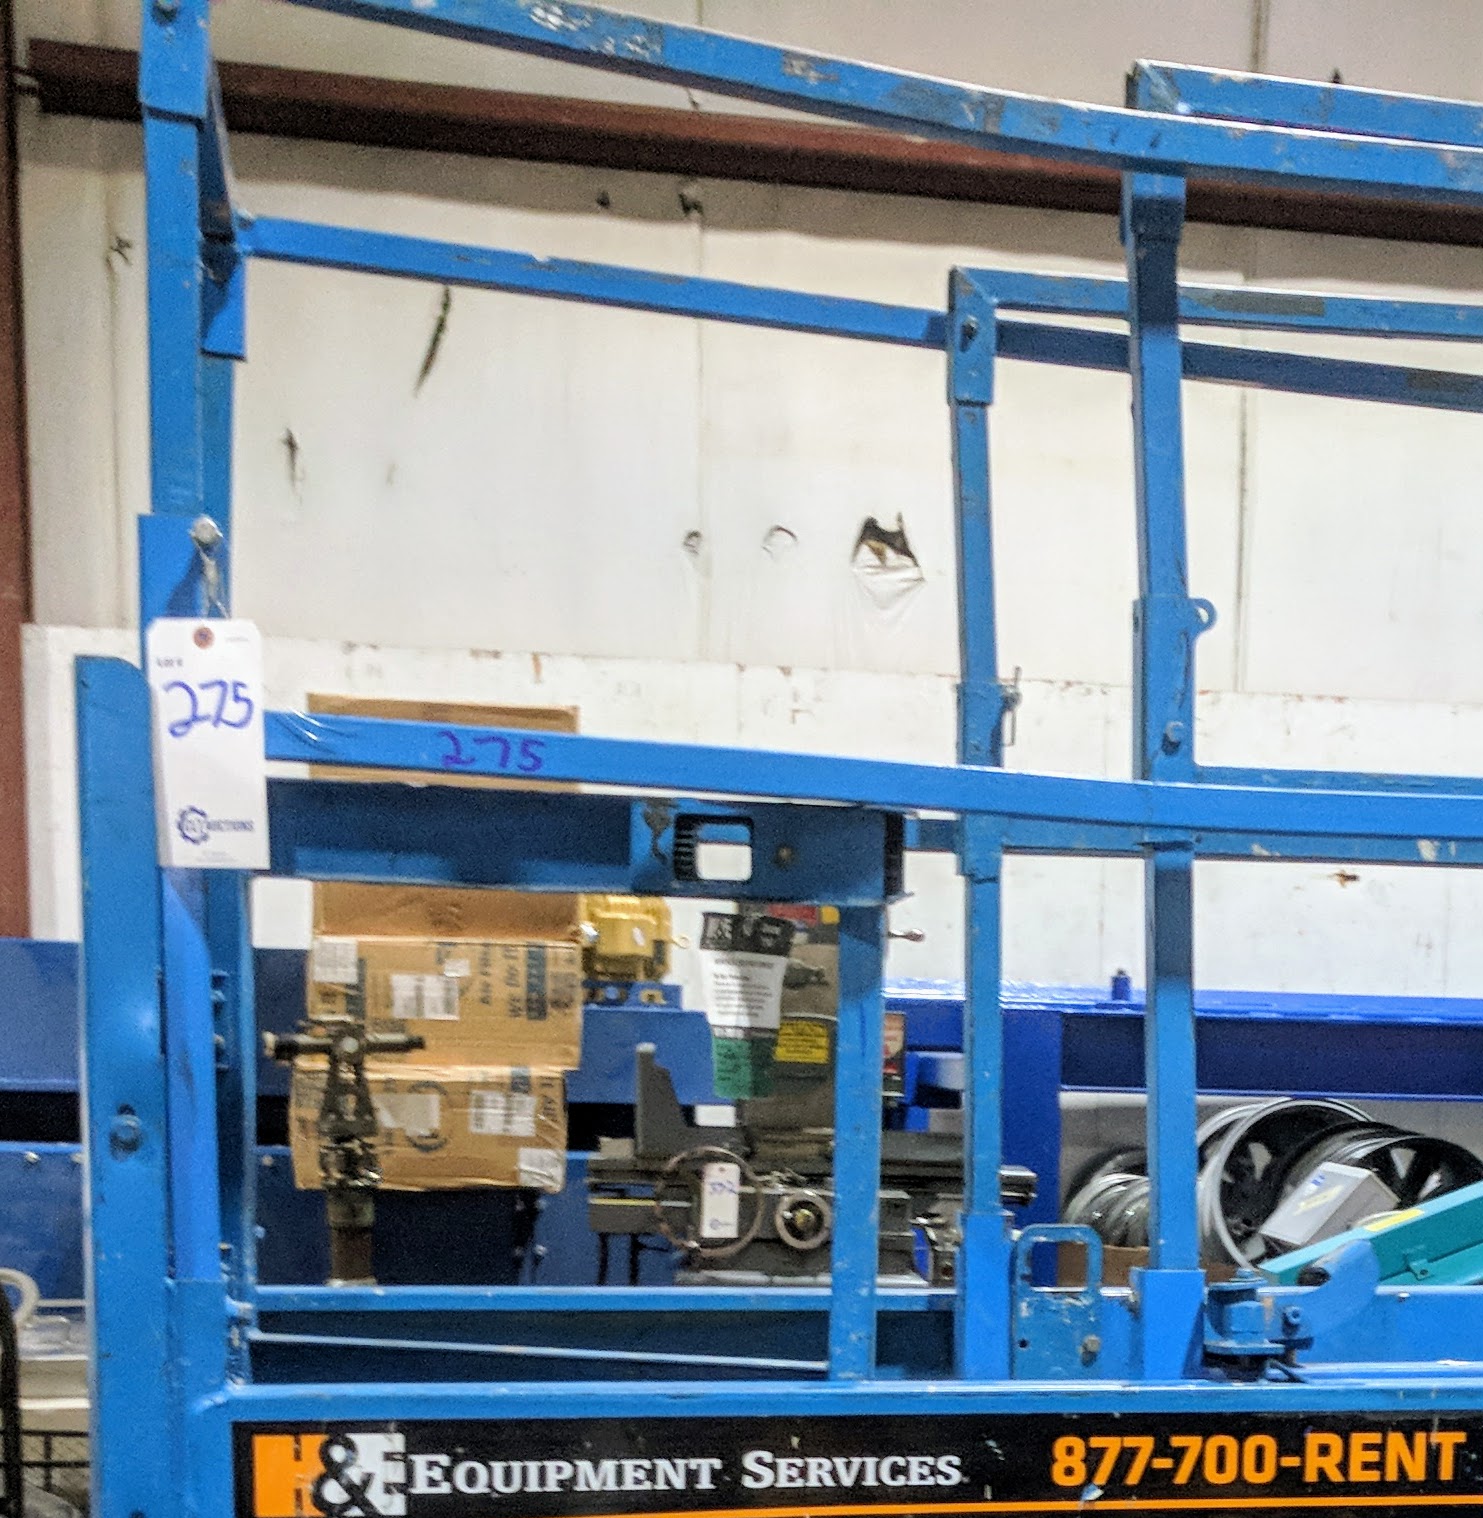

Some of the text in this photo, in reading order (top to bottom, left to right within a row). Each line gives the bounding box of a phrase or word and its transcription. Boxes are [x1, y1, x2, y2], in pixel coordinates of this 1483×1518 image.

[163, 680, 254, 737] 275
[438, 730, 545, 772] 275
[252, 1431, 1467, 1518] H&E EQUIPMENT SERVICES 877-700-RENT
